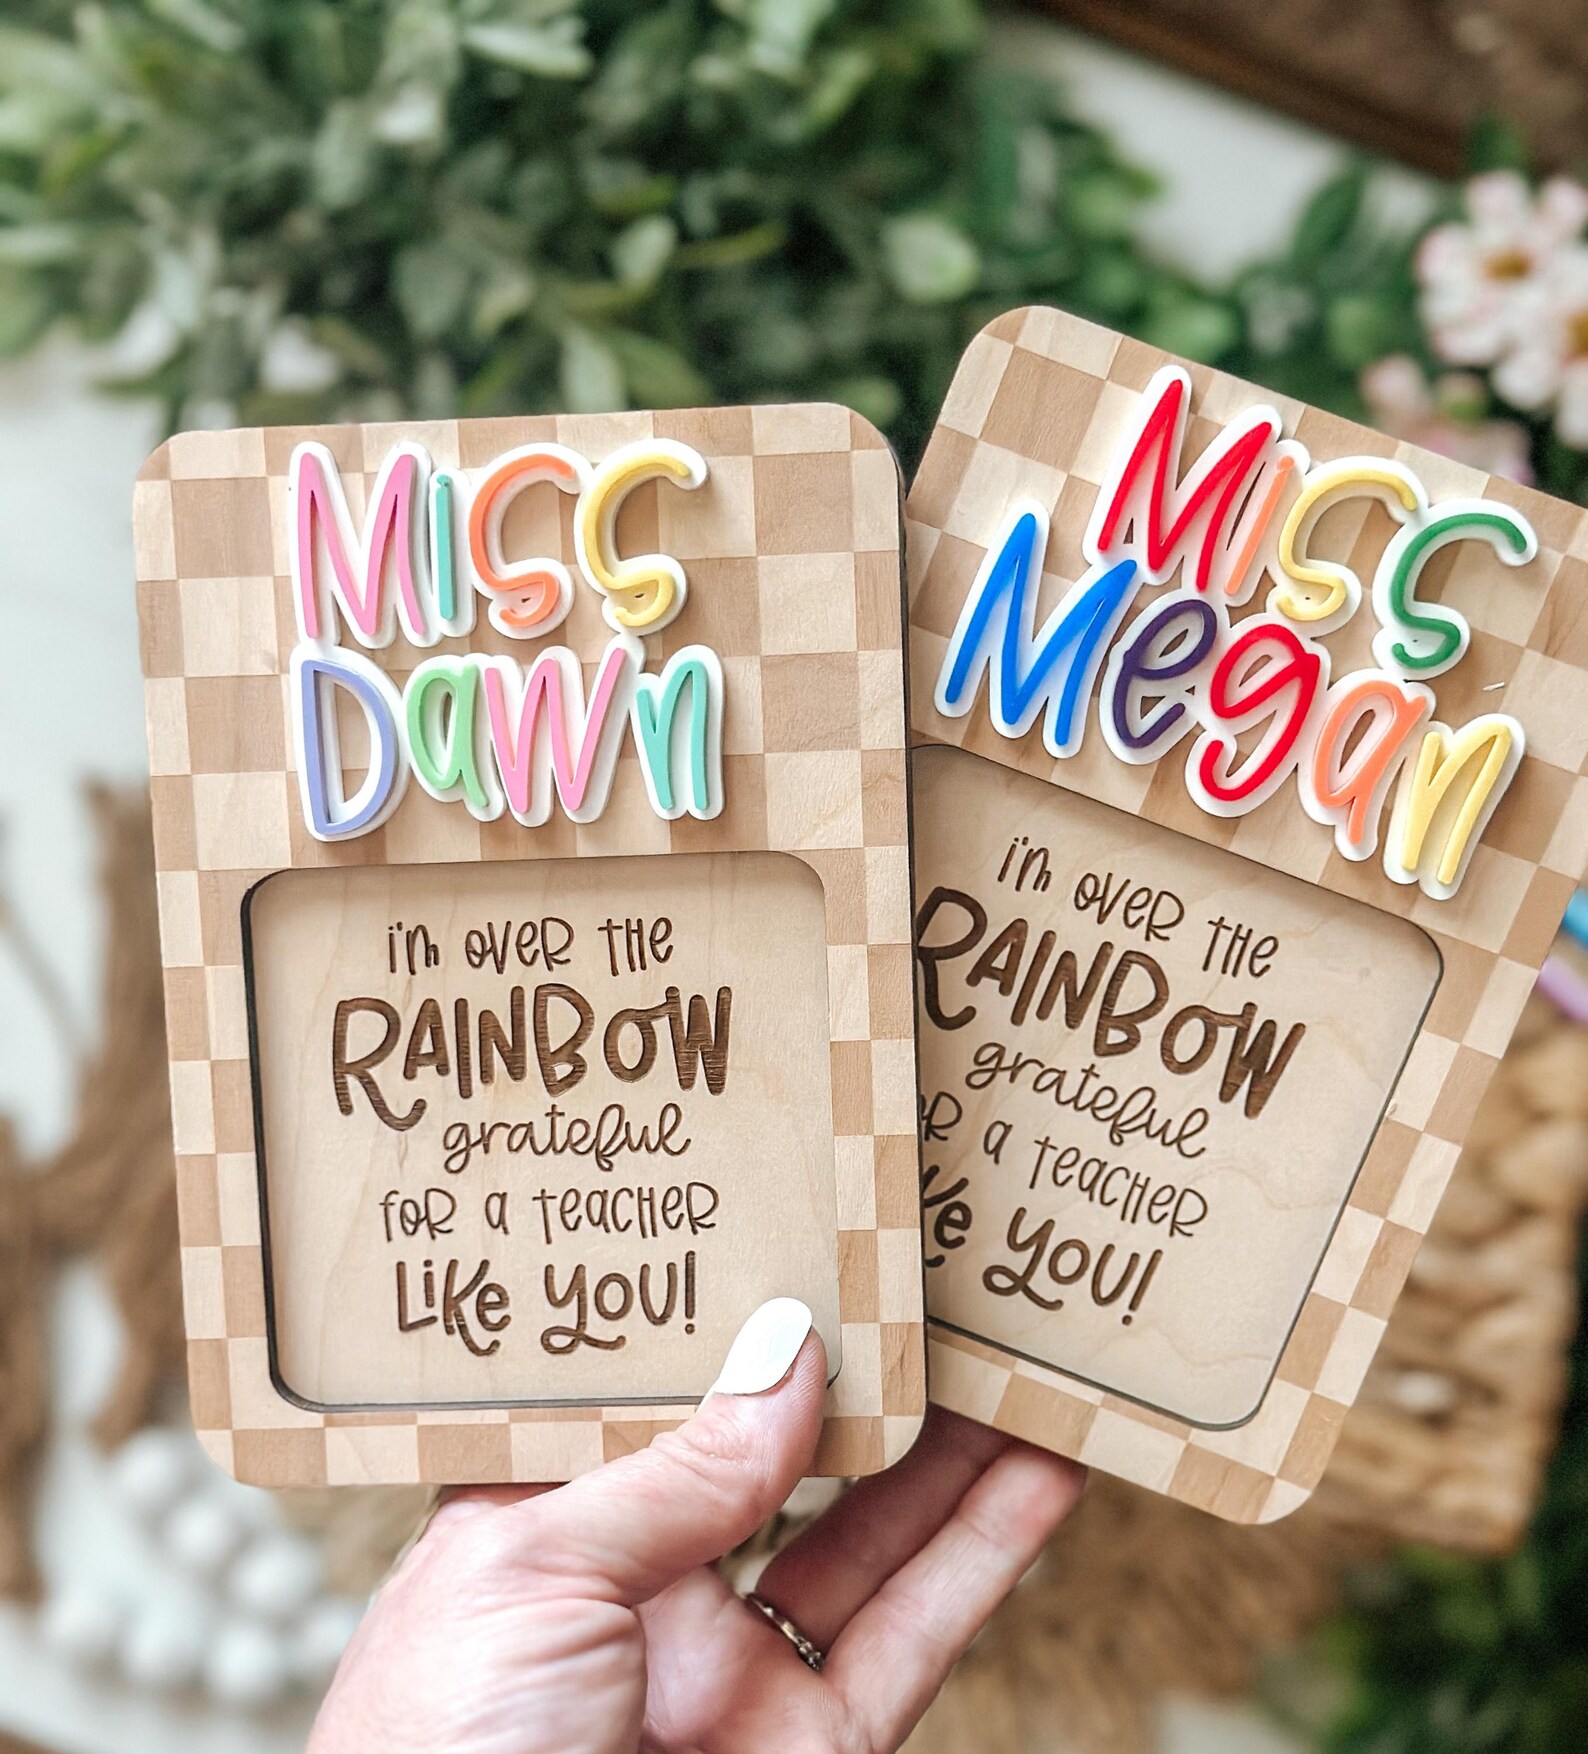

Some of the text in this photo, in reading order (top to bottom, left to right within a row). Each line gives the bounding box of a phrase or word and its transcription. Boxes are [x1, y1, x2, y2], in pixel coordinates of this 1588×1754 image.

[944, 511, 1513, 886] Megan
[965, 1043, 1210, 1158] grateful
[443, 1102, 692, 1175] grateful
[983, 1120, 1014, 1166] a
[485, 1192, 510, 1236] a
